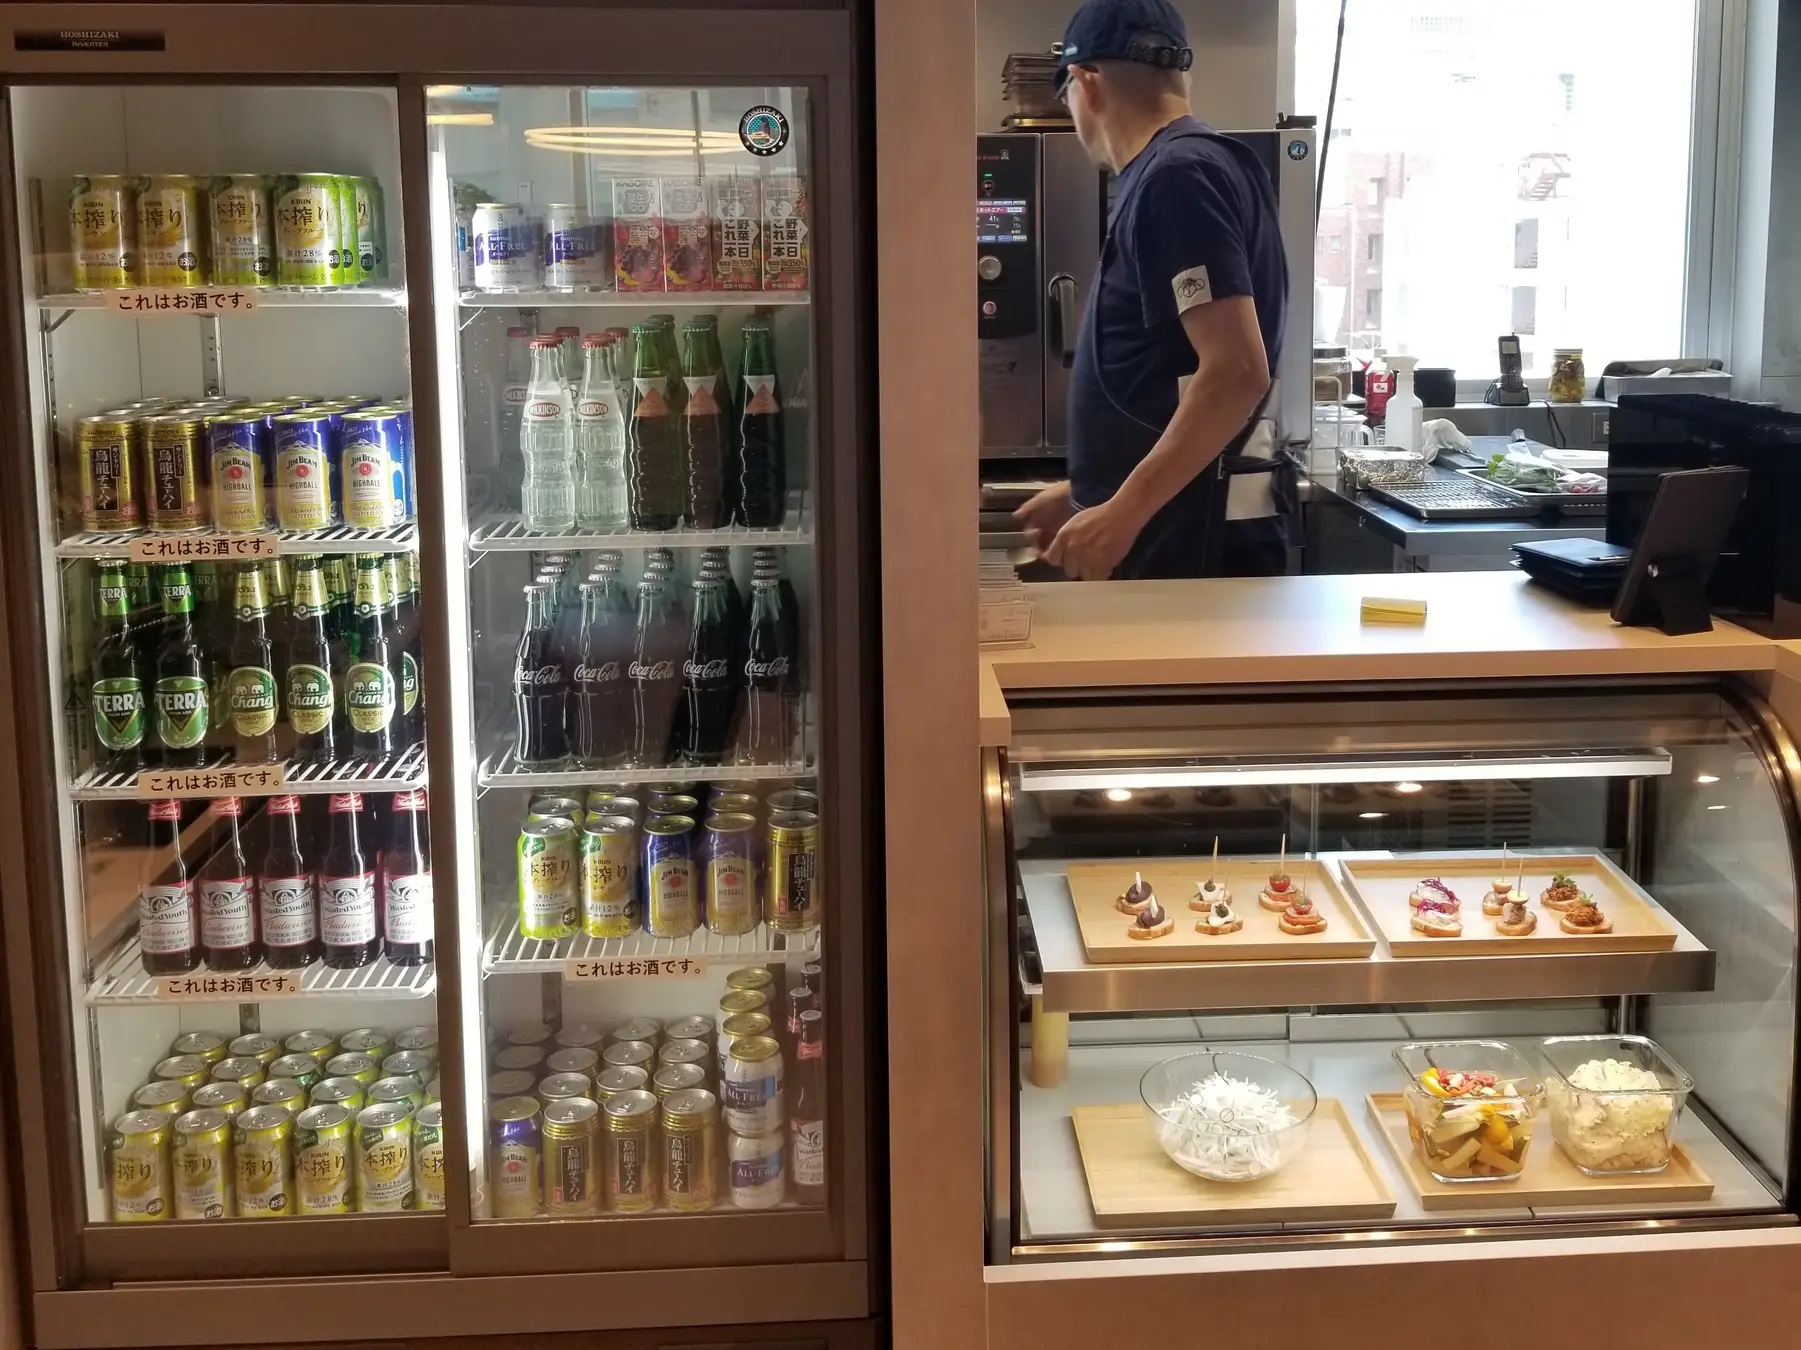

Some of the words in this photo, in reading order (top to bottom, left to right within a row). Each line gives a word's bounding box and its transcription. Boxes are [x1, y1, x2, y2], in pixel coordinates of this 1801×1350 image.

[60, 31, 120, 39] HOSHIZAKI
[743, 107, 785, 123] HOSHIZAKI
[276, 207, 329, 226] 本搾り
[773, 218, 785, 258] これ一本
[785, 218, 798, 258] 野菜一日
[119, 292, 255, 310] これはお酒です。
[531, 404, 560, 415] WILKINSON
[580, 404, 607, 415] WILKINSON
[220, 459, 232, 471] JIM
[232, 457, 251, 470] BEAM
[286, 458, 298, 470] JIM
[298, 455, 318, 468] BEAM
[350, 457, 362, 467] JIM
[362, 453, 381, 467] BEAM
[222, 483, 252, 491] HIGHBALL
[352, 480, 381, 488] HIGHBALL
[142, 538, 274, 556] これはお酒です。
[100, 587, 128, 599] TERRA
[162, 584, 192, 597] TERRA
[573, 660, 620, 683] Coca-Cola
[628, 660, 675, 680] Coca-Cola
[682, 658, 728, 678] Coca-Cola
[744, 655, 790, 677] Coca-Cola
[514, 664, 561, 685] Coca-Cola
[93, 691, 145, 713] TERRA
[155, 690, 207, 711] TERRA
[231, 694, 273, 709] Chang
[288, 691, 329, 707] Chang
[348, 689, 387, 706] Chang
[237, 712, 269, 720] CLASSIC
[292, 710, 324, 718] CLASSIC
[150, 771, 280, 791] これはお酒です。
[531, 859, 570, 877] 本搾り
[580, 864, 628, 885] 本搾り
[660, 869, 673, 881] JIM
[673, 866, 689, 877] BEAM
[716, 867, 728, 878] JIM
[223, 904, 248, 917] Youth
[287, 901, 311, 912] Youth
[389, 904, 416, 912] Wasted
[576, 958, 701, 977] これはお酒です。
[169, 976, 296, 994] これはお酒です。
[364, 1147, 408, 1168] 本搾り
[296, 1155, 346, 1177] 本搾り
